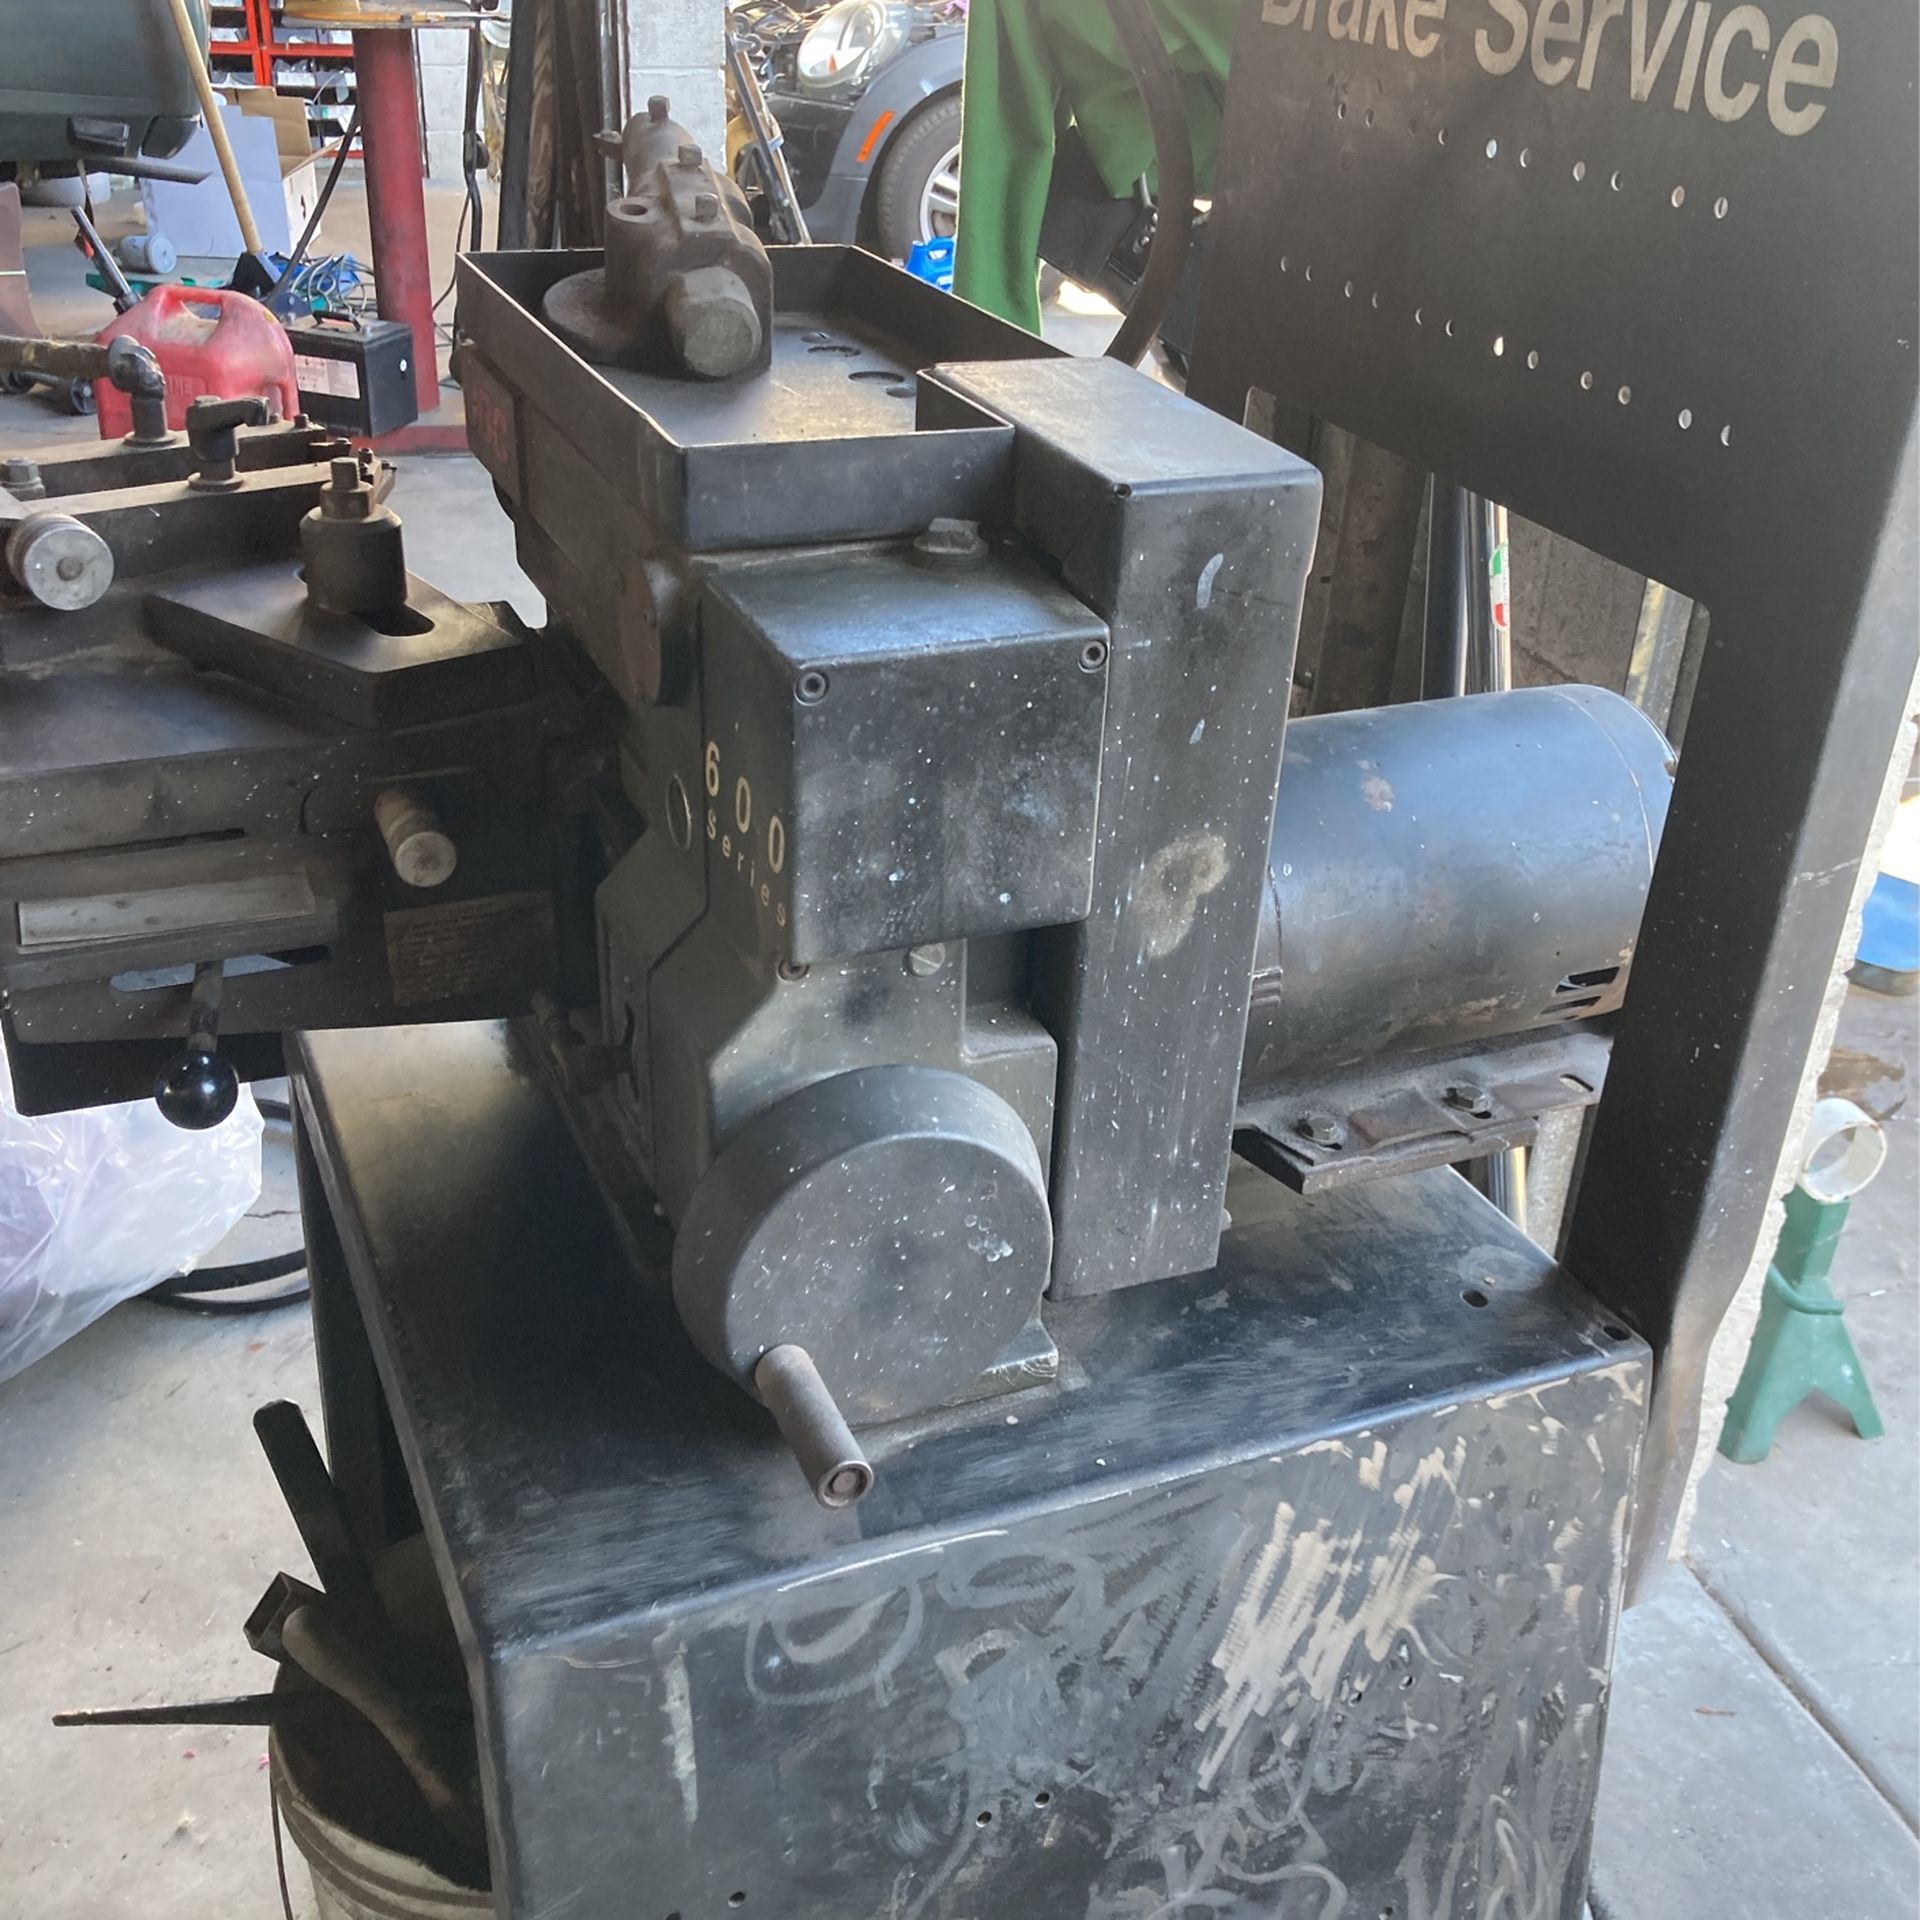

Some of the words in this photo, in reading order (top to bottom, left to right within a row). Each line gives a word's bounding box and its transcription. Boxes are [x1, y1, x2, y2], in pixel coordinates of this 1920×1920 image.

[1261, 0, 1447, 58] ake
[1474, 0, 1839, 136] Service
[705, 741, 785, 874] 600
[706, 808, 786, 927] Series
